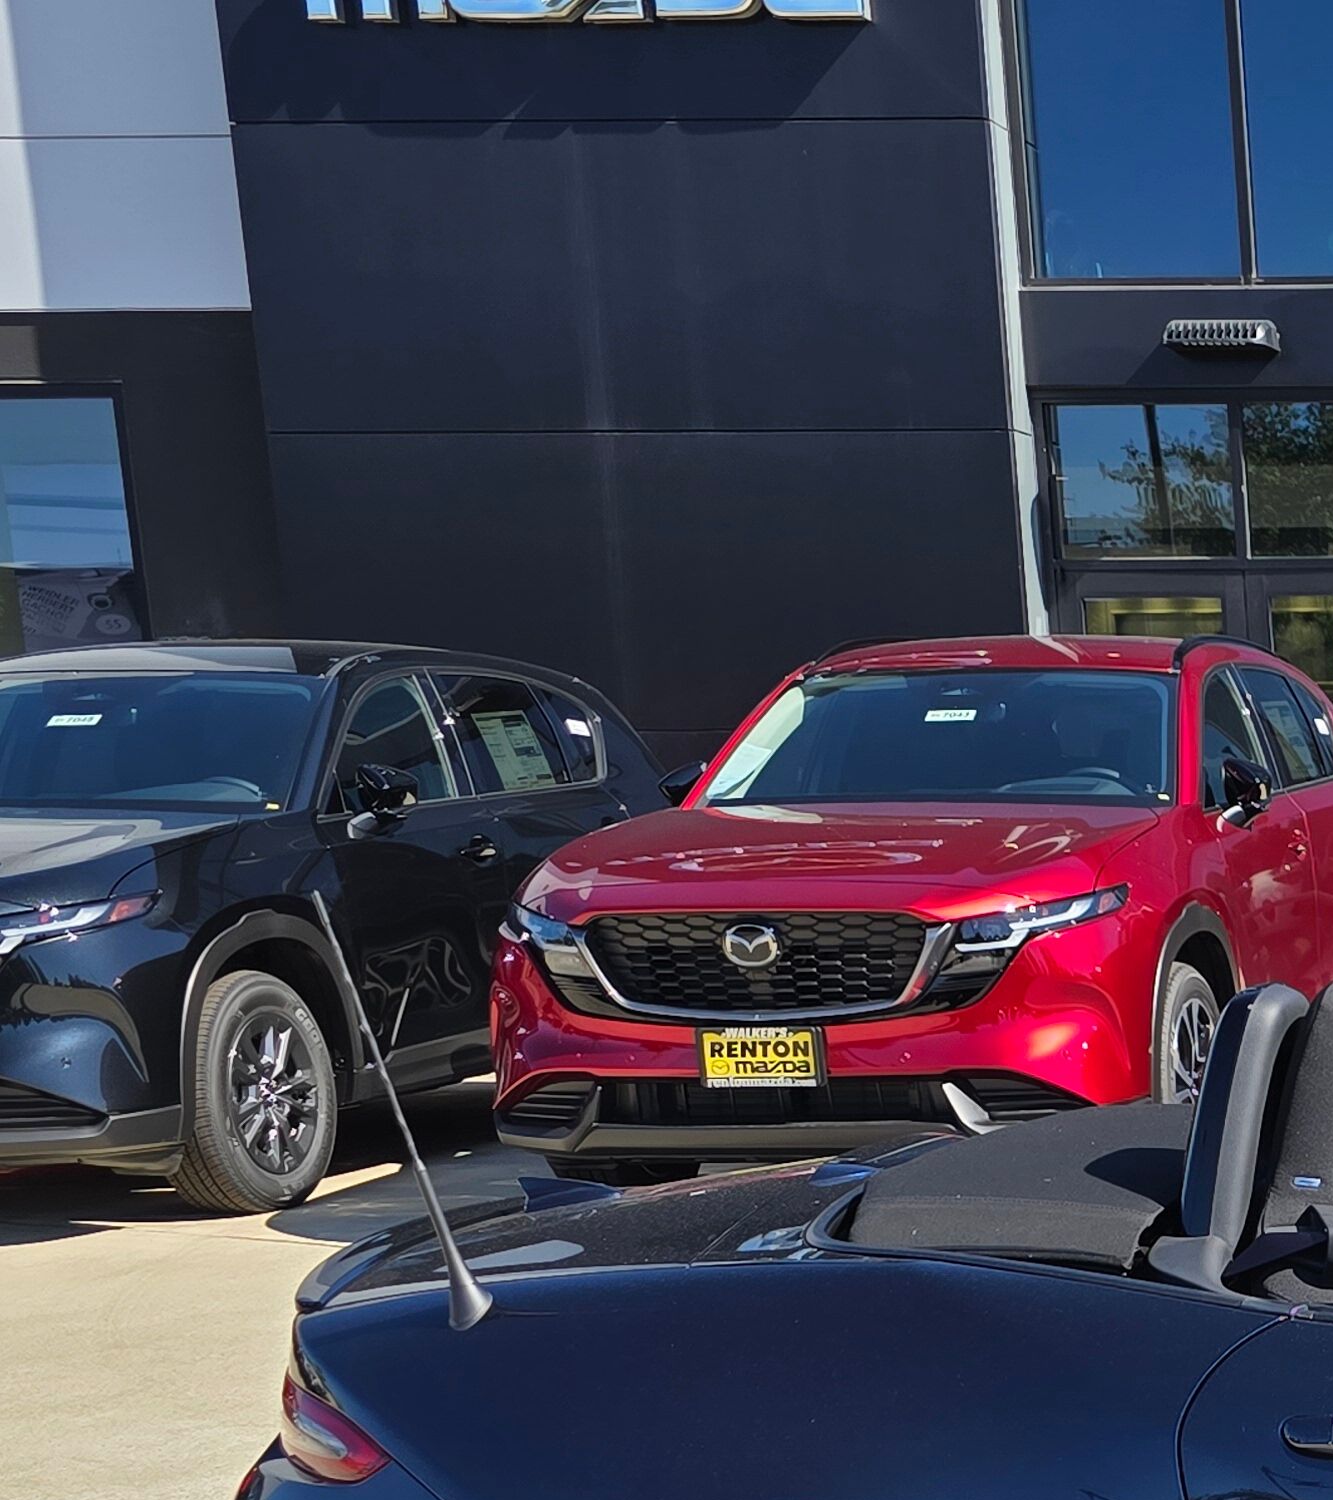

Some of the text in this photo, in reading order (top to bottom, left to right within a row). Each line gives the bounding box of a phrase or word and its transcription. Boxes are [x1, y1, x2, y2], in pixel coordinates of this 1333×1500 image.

[724, 1027, 788, 1039] WALKER'S
[710, 1041, 810, 1058] RENTON
[735, 1060, 811, 1073] mazda
